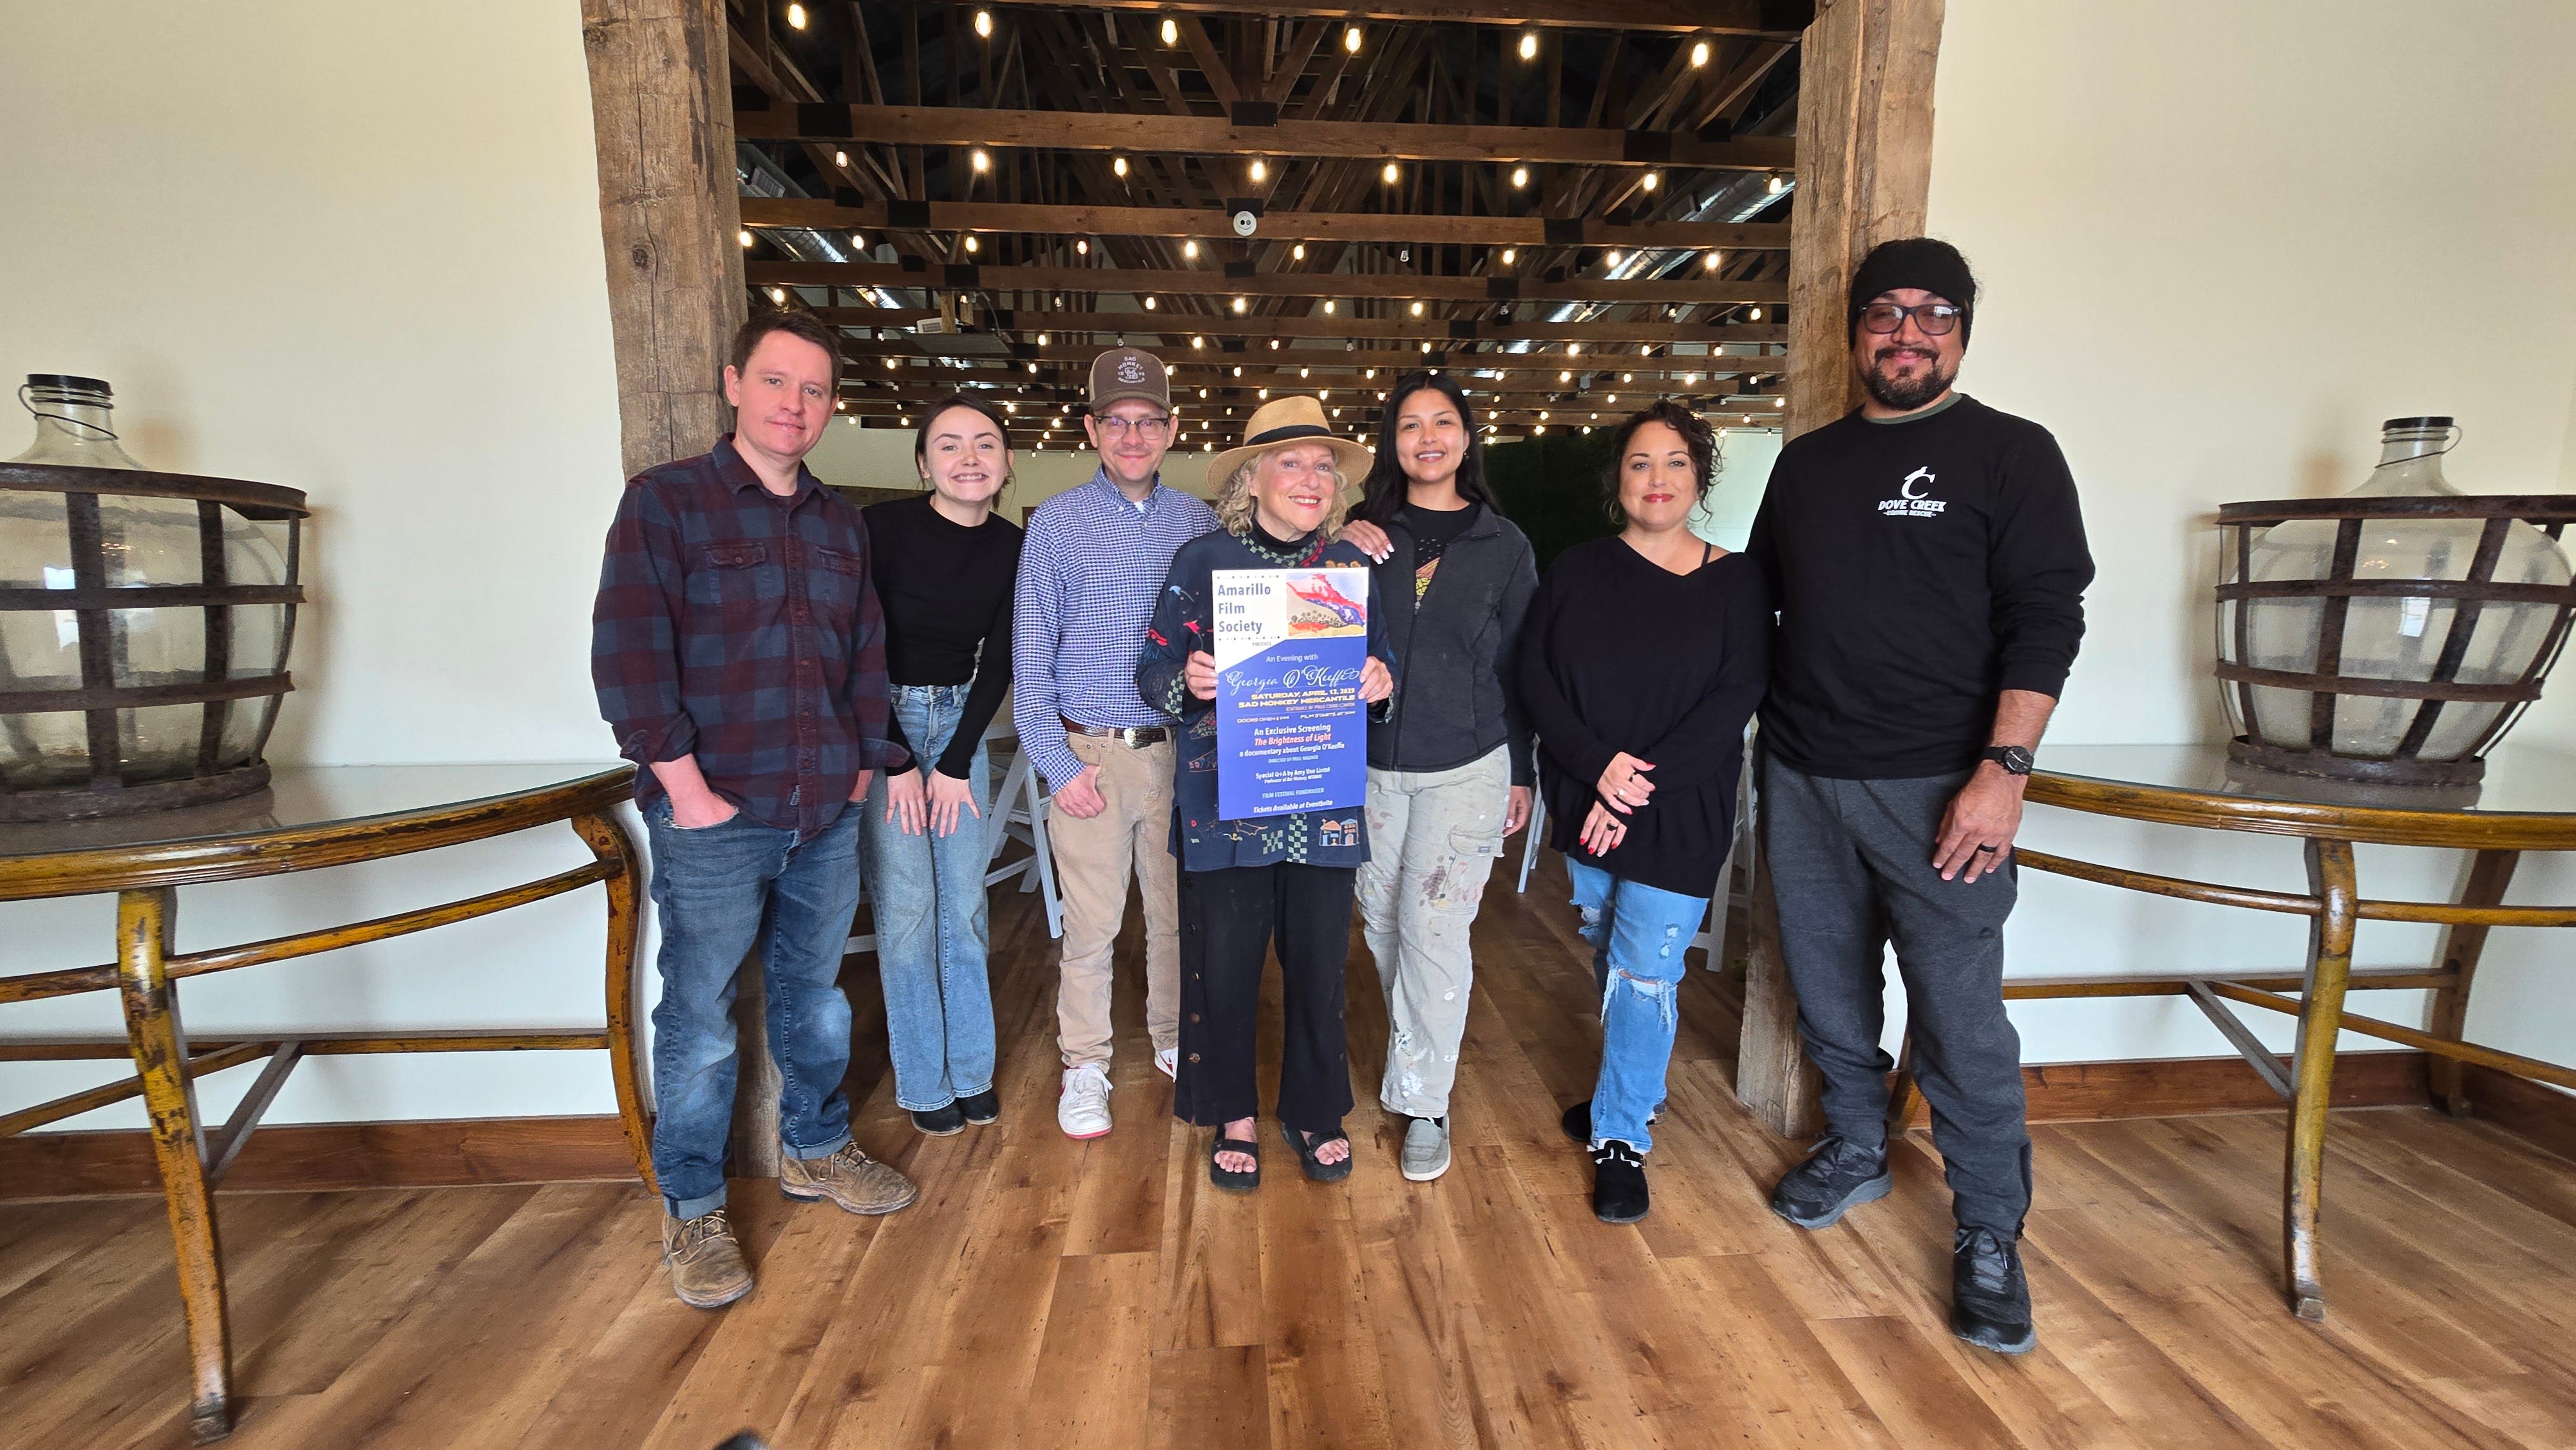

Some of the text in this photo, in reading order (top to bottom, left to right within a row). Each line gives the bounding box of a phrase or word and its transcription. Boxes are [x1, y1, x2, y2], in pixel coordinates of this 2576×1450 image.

[1878, 500, 1947, 512] DOVE CREEK
[1218, 583, 1271, 596] Amarillo
[1218, 602, 1245, 614] Film
[1219, 620, 1262, 634] Society
[1276, 654, 1302, 663] Evening
[1225, 670, 1279, 696] Georgia
[1251, 692, 1301, 700] SATURDAY,
[1260, 699, 1299, 707] MONKEY
[1300, 695, 1356, 704] MERCANTILE
[1265, 726, 1296, 735] Exclusive
[1298, 723, 1331, 733] Screening
[1268, 735, 1304, 746] Brightness
[1305, 733, 1313, 742] of
[1314, 733, 1331, 743] Light
[1244, 748, 1282, 757] documentary
[1300, 744, 1321, 752] Georgia
[1273, 802, 1299, 811] Available
